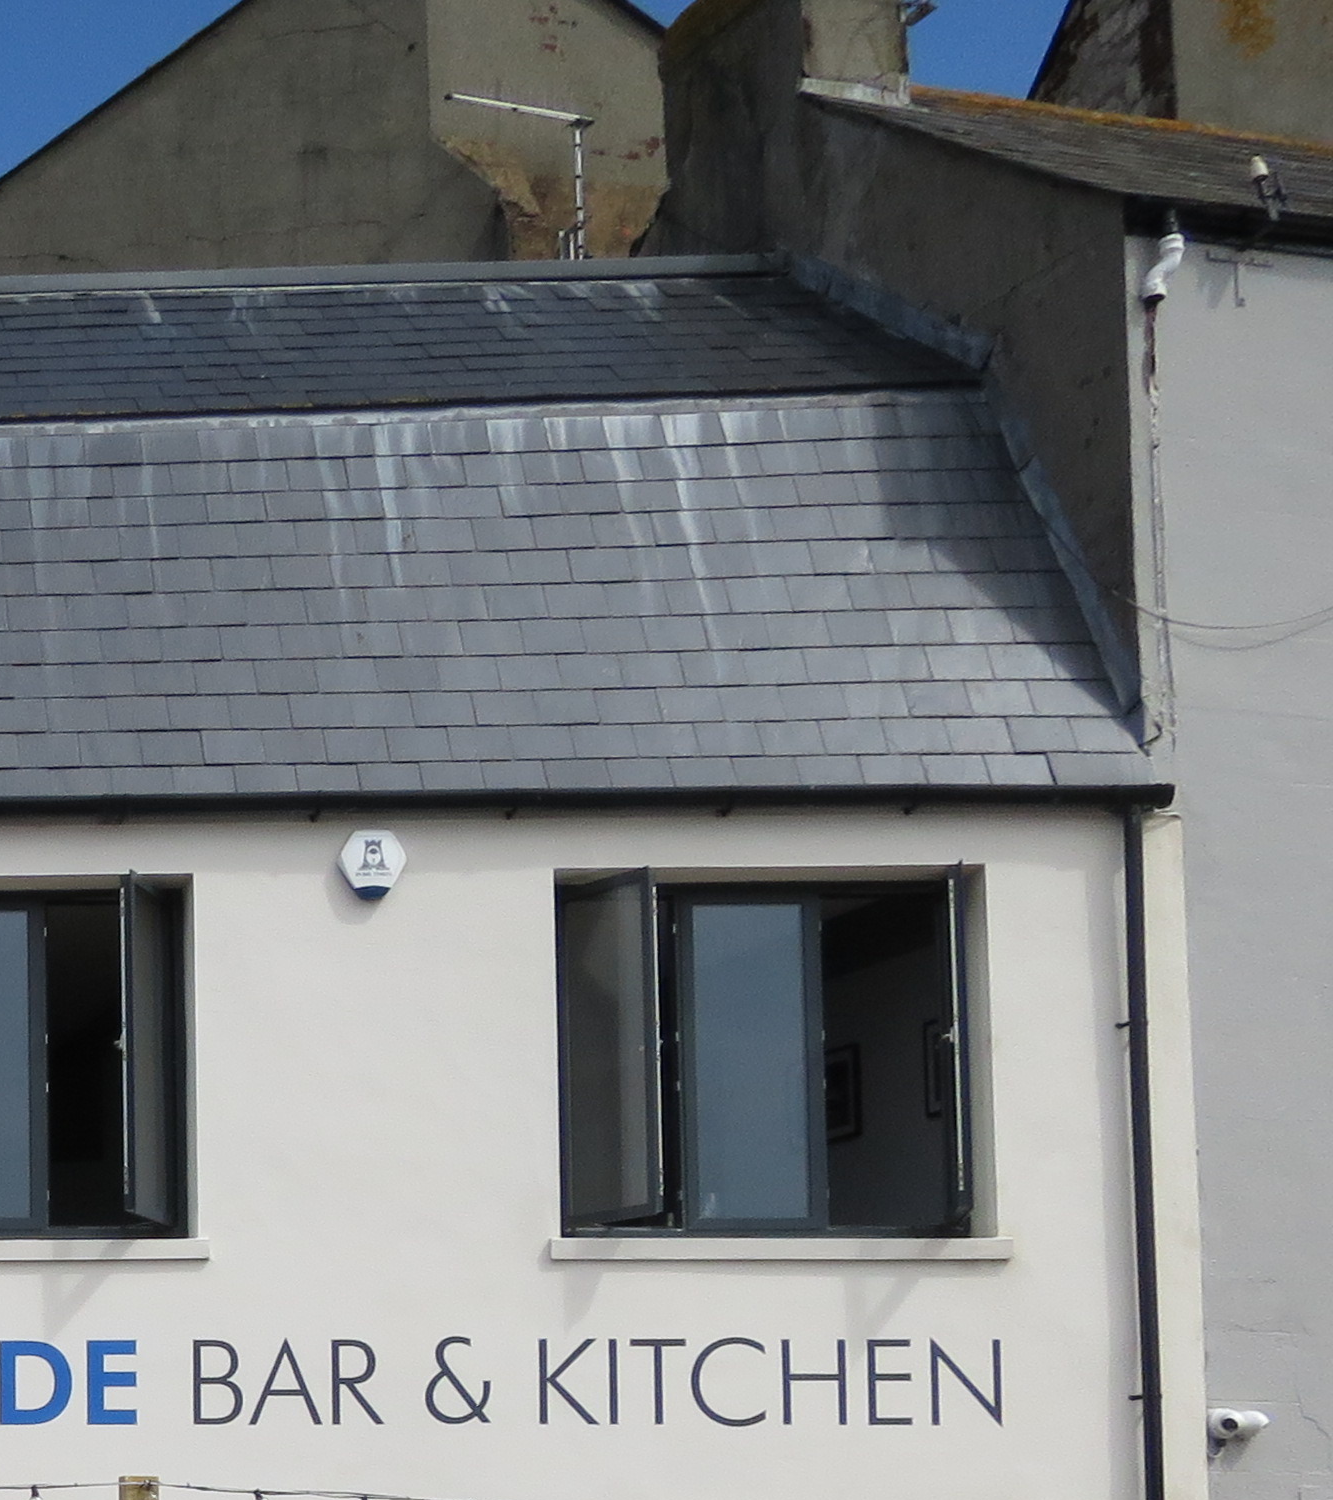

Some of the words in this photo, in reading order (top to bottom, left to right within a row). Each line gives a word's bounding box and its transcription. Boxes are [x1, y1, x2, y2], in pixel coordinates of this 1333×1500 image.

[191, 1338, 384, 1425] BAR
[424, 1336, 492, 1425] &
[539, 1337, 1004, 1426] KITCHEN
